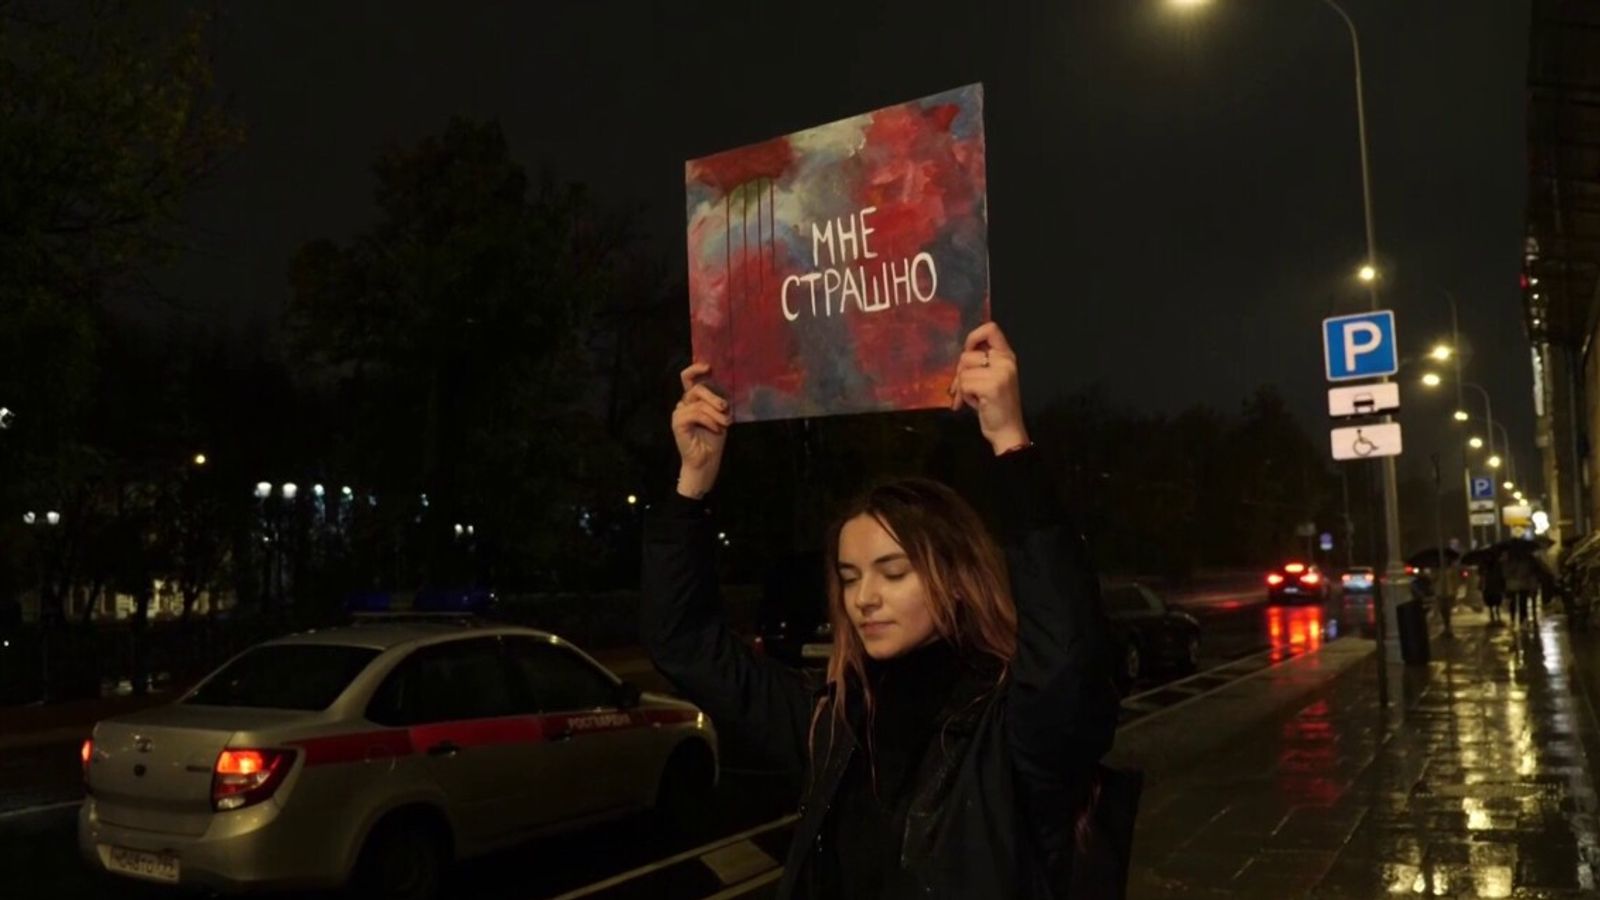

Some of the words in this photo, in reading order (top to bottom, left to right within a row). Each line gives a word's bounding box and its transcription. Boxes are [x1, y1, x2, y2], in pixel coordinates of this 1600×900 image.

[812, 206, 878, 267] МНЕ
[781, 252, 937, 321] СТРАШНО
[1343, 321, 1382, 372] P
[1475, 479, 1490, 497] P
